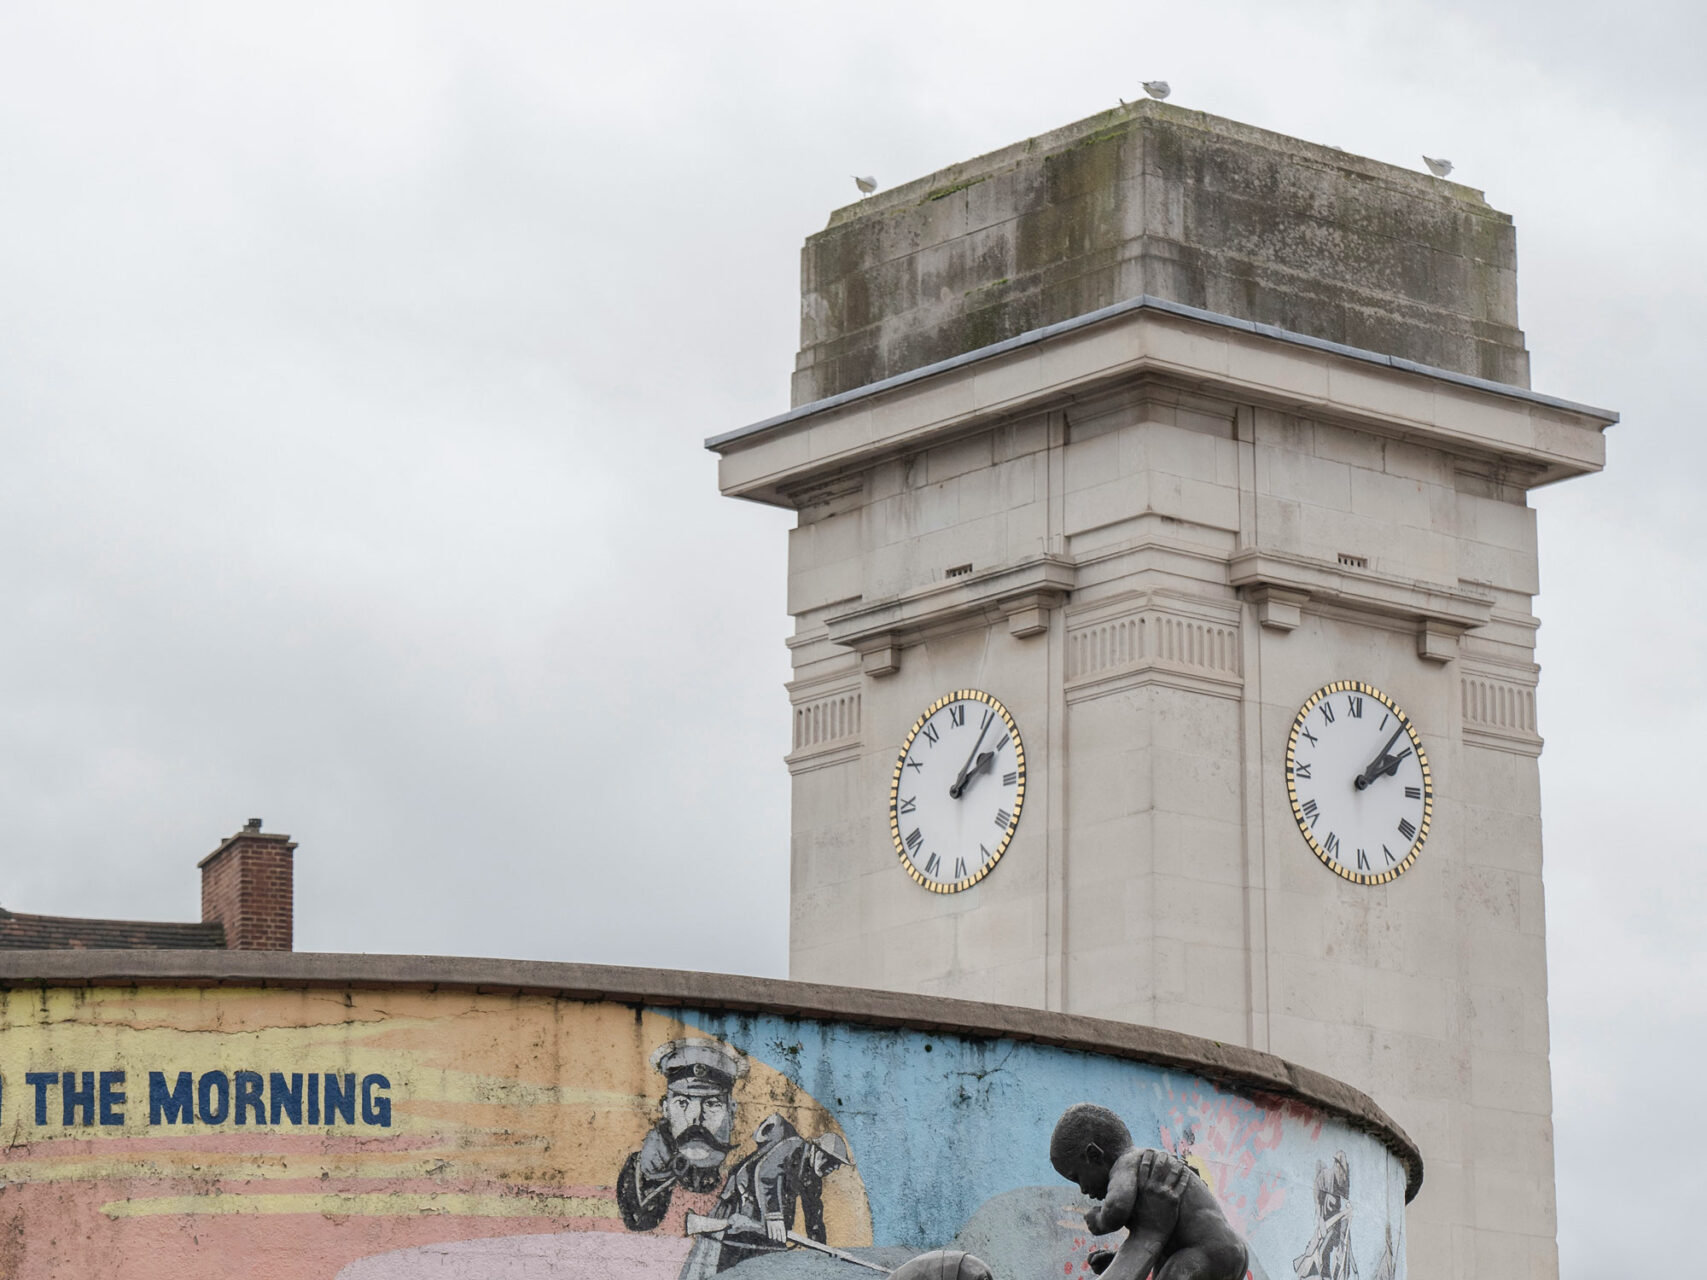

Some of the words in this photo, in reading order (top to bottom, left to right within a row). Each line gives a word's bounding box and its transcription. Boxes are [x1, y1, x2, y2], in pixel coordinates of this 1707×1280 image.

[949, 704, 964, 729] XII
[1319, 701, 1335, 727] XI
[1348, 695, 1363, 719] XII
[922, 722, 940, 748] XI
[996, 733, 1010, 751] II
[1302, 726, 1318, 748] X
[906, 756, 923, 774] X
[1296, 760, 1311, 779] IX
[1003, 771, 1017, 787] III
[1405, 786, 1421, 800] III
[900, 796, 916, 814] IX
[980, 843, 990, 864] V
[1324, 831, 1340, 859] VII
[1382, 844, 1396, 865] V
[924, 852, 941, 878] VII
[955, 856, 967, 879] VI
[1357, 849, 1370, 871] VI
[25, 1071, 126, 1126] THE
[149, 1070, 391, 1127] MORNING
